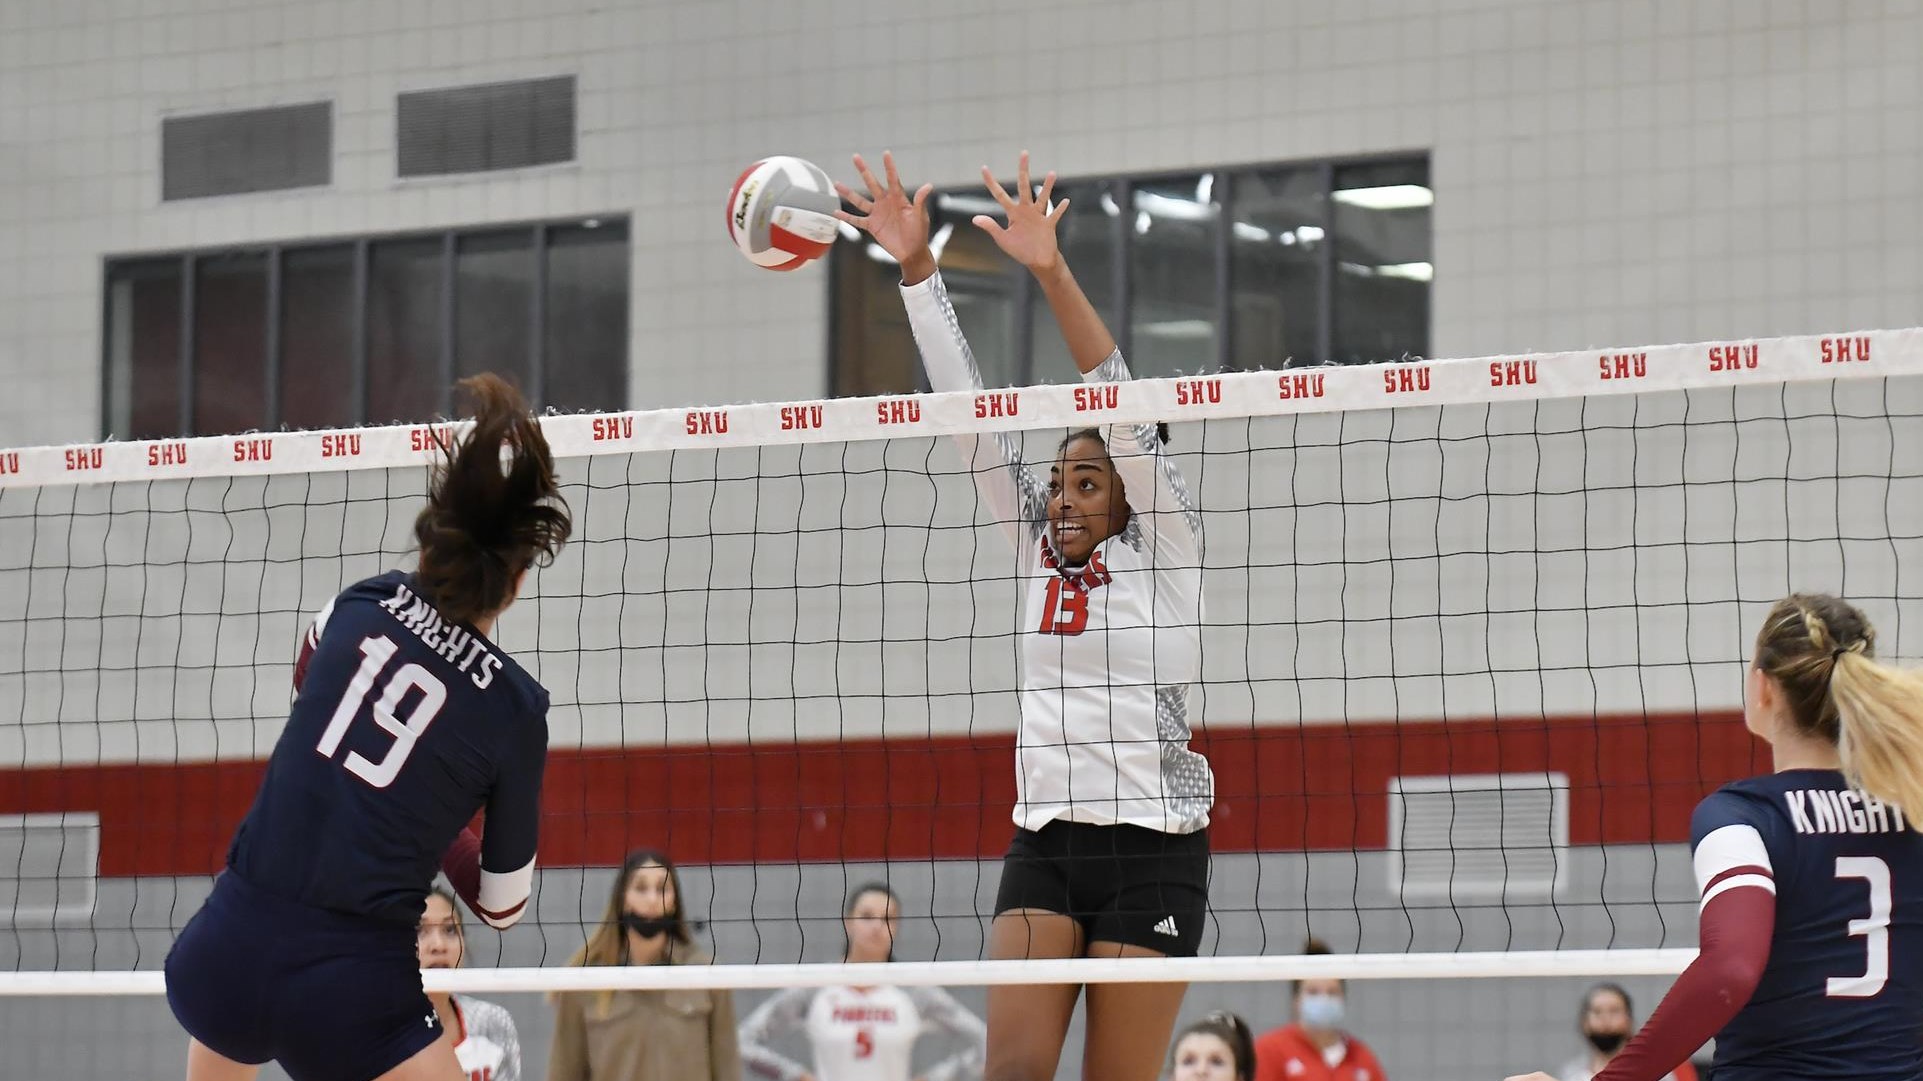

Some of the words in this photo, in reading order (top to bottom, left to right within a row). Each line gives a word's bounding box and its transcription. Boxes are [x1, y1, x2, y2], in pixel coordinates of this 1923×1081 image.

[64, 447, 104, 471] SHU
[147, 443, 188, 467] SHU
[232, 438, 274, 463] SHU
[321, 433, 362, 458] SHU
[409, 427, 454, 453] SHU
[591, 416, 634, 442] SHU
[685, 410, 730, 436] SHU
[780, 404, 824, 431] SHU
[876, 399, 922, 425] SHU
[974, 392, 1020, 419] SHU
[1072, 384, 1120, 412] SHU
[1175, 379, 1223, 407] SHU
[1278, 373, 1326, 401] SHU
[1383, 366, 1431, 395] SHU
[1488, 359, 1539, 388] SHU
[1599, 352, 1648, 381] SHU
[1708, 343, 1760, 373] SHU
[1820, 336, 1872, 365] SHU
[379, 583, 504, 690] KNIGHTS
[1039, 576, 1089, 636] 13
[315, 634, 448, 788] 19
[1784, 789, 1905, 834] KNIGHT
[1826, 856, 1892, 997] 3
[854, 1030, 874, 1060] 5
